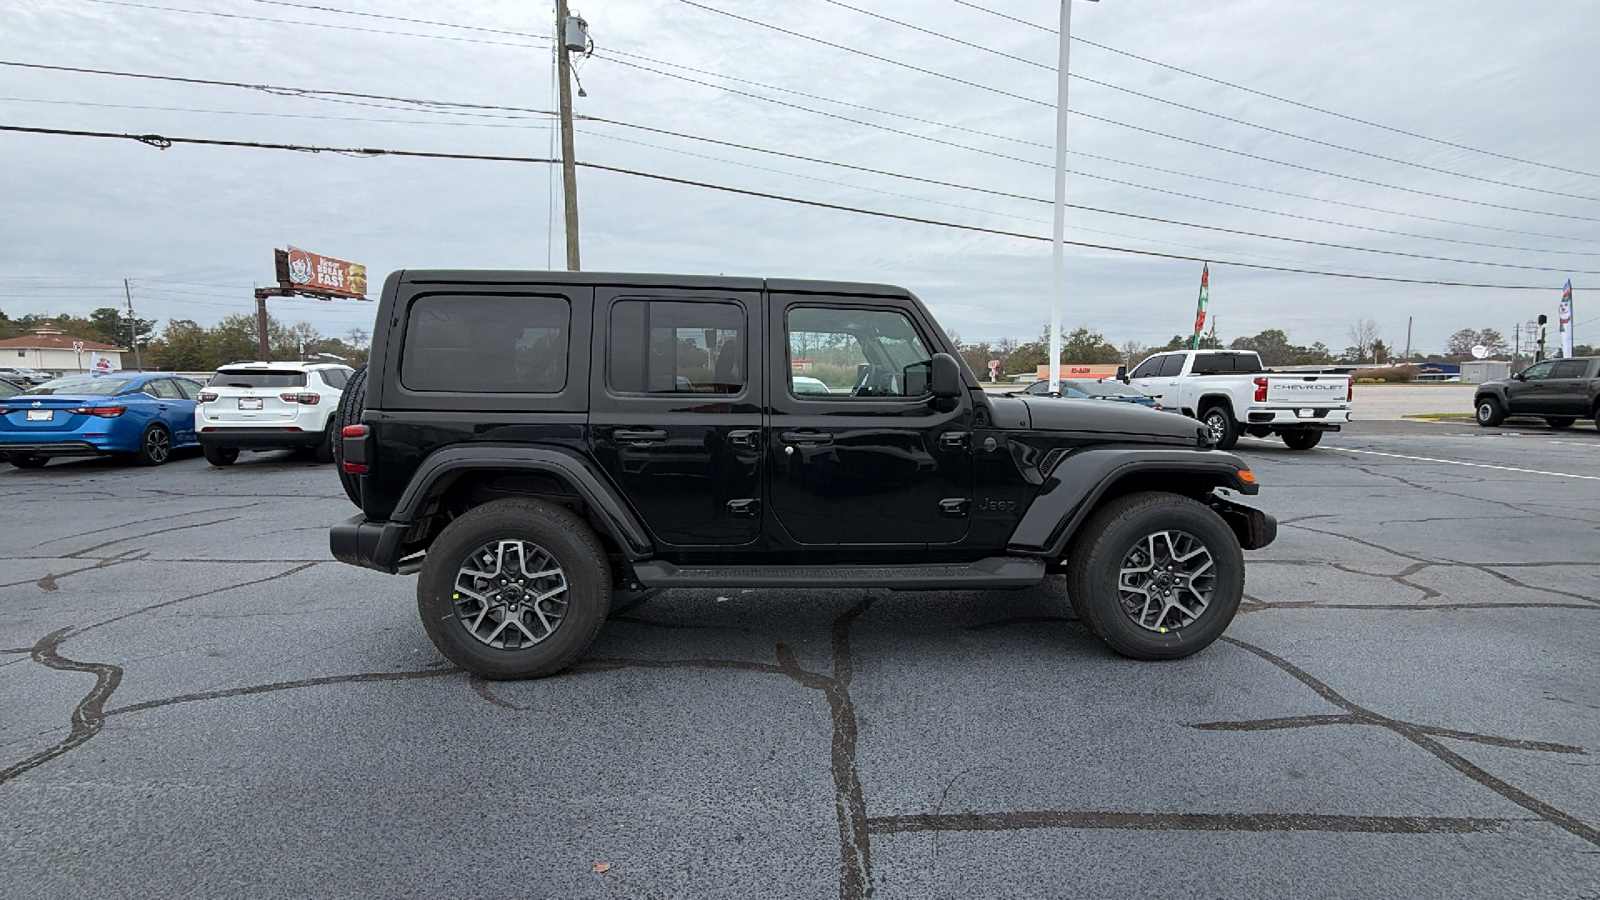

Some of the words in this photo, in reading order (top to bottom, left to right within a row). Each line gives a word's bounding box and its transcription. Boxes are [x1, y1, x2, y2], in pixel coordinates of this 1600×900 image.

[317, 264, 344, 278] BREAK
[317, 273, 344, 288] FAST
[978, 497, 1016, 513] Jeep
